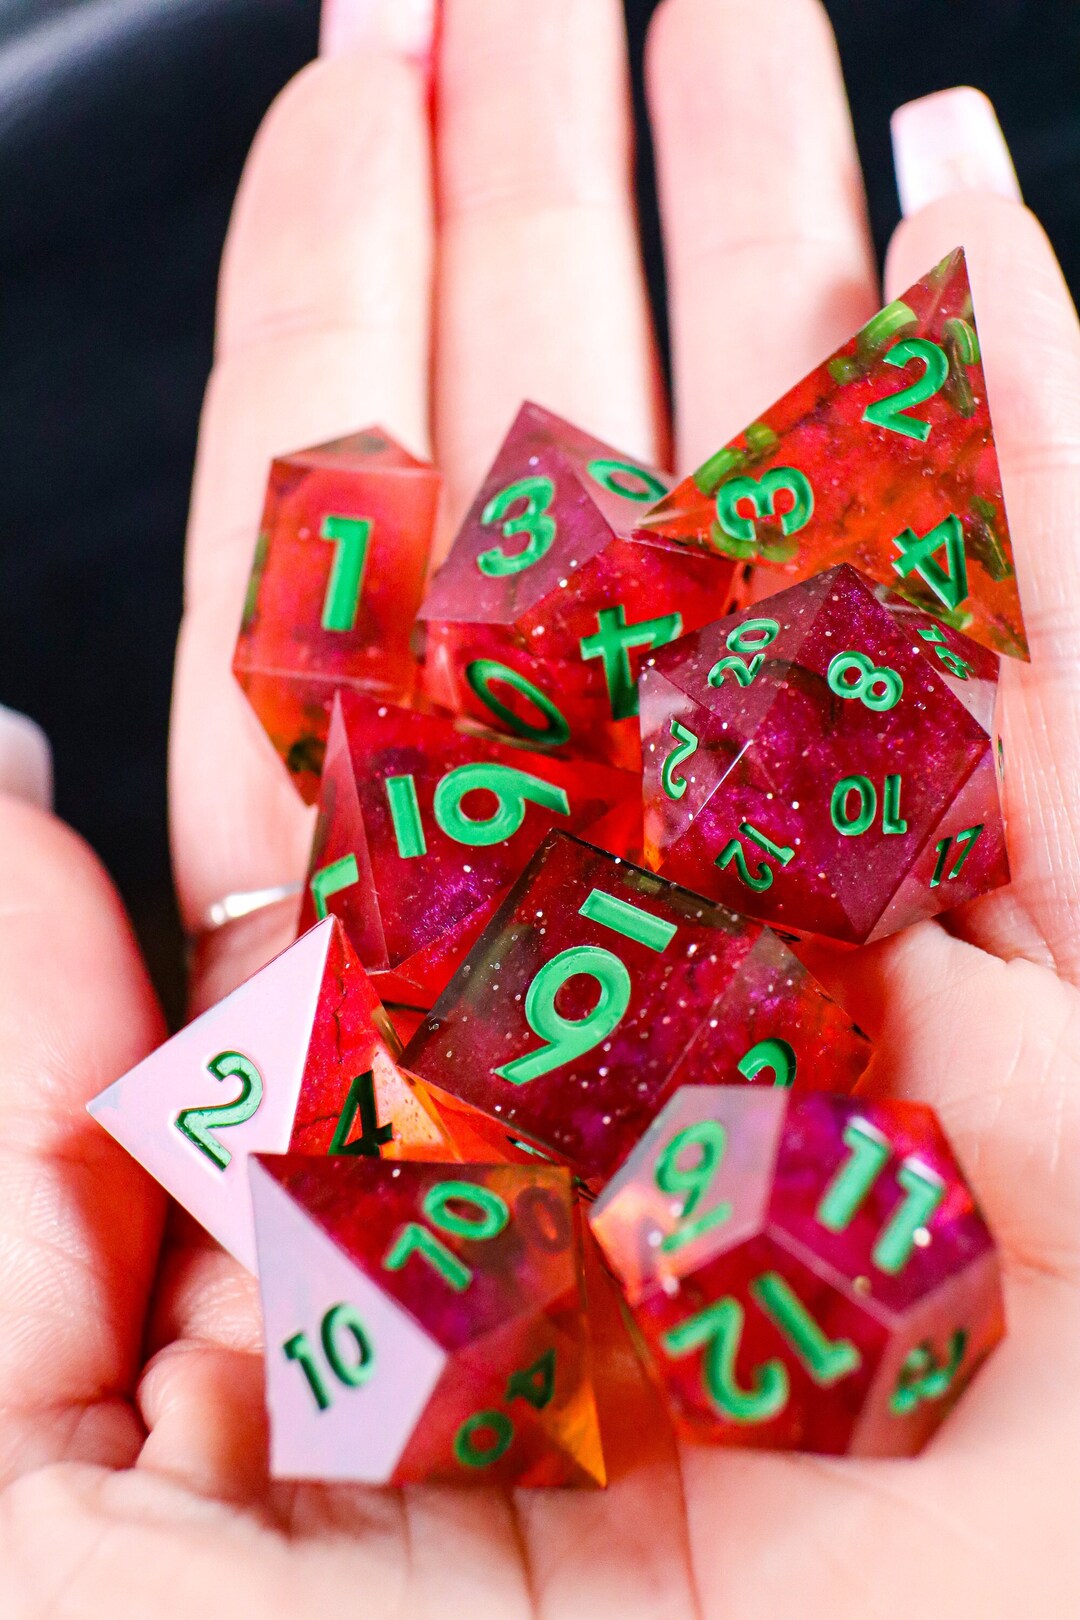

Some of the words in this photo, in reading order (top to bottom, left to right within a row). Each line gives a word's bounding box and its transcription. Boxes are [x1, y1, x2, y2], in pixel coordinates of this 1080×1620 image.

[862, 337, 950, 442] 2
[477, 476, 556, 577] 3
[716, 467, 815, 542] 3
[320, 515, 373, 633] 1
[892, 513, 969, 612] 4
[580, 604, 684, 721] 4
[707, 617, 781, 688] 20
[827, 650, 904, 712] 8
[661, 719, 698, 801] 2
[830, 774, 907, 836] 10
[714, 822, 796, 894] 12
[929, 823, 984, 888] 17
[174, 1050, 264, 1172] 2
[327, 1069, 394, 1156] 4
[383, 1179, 511, 1292] 70
[816, 1114, 946, 1276] 11
[282, 1301, 376, 1412] 10
[664, 1270, 863, 1425] 12
